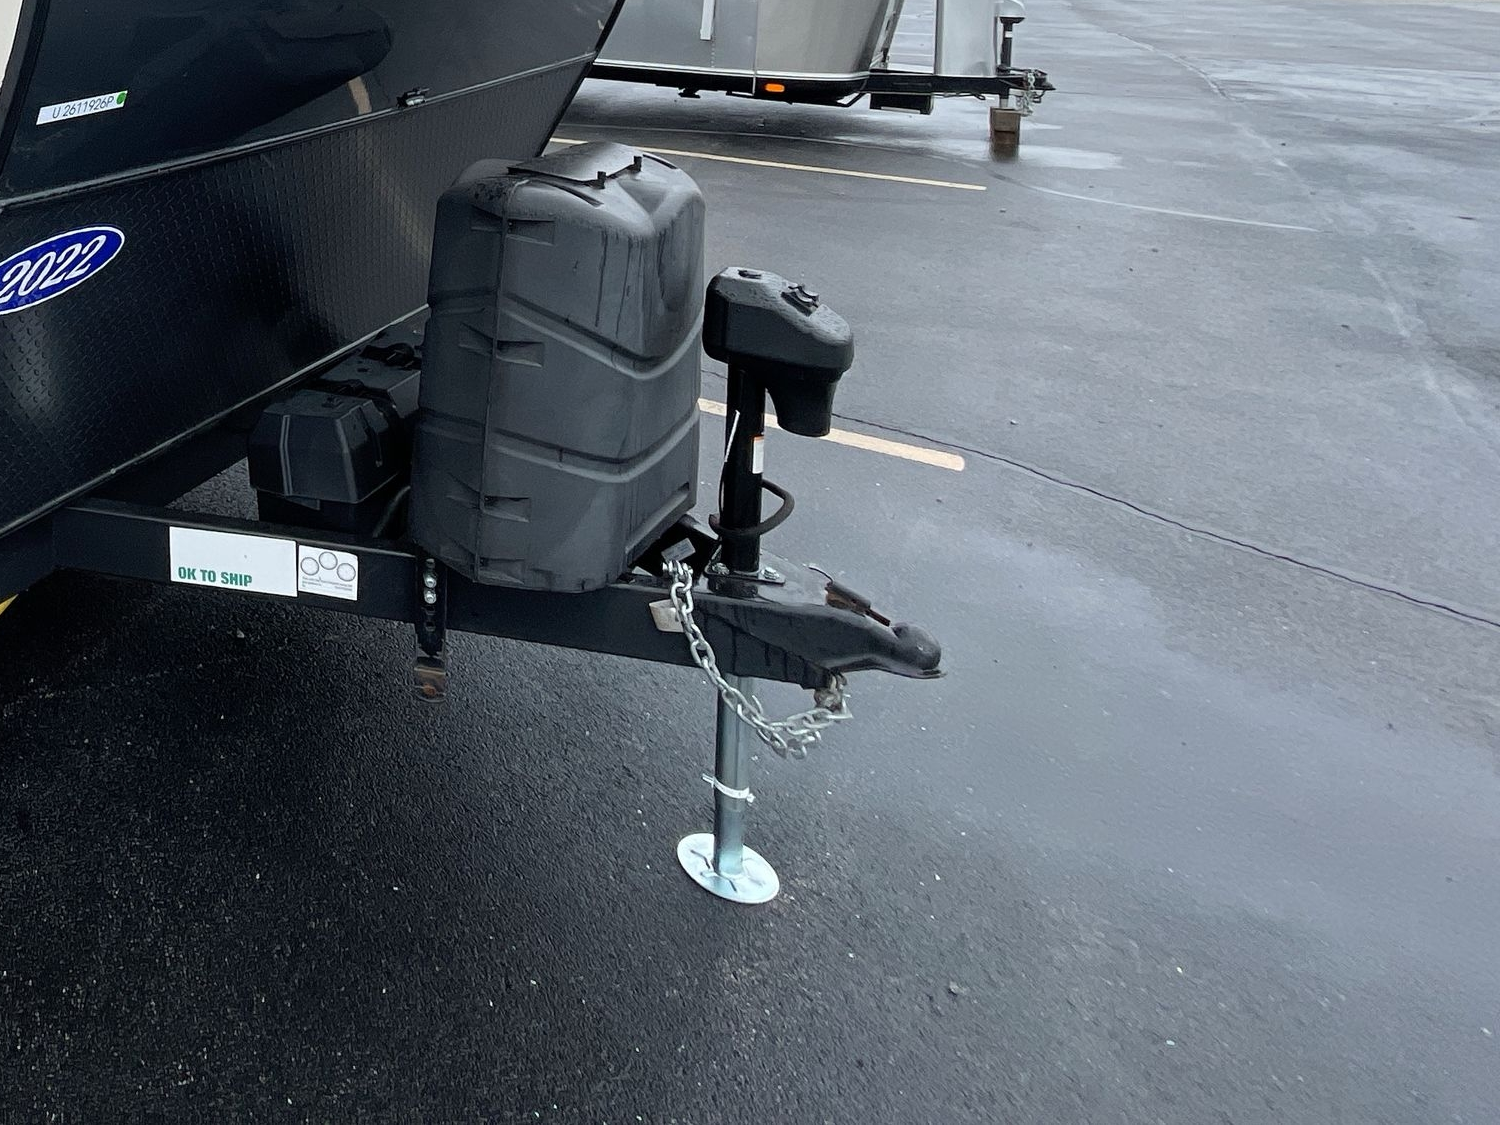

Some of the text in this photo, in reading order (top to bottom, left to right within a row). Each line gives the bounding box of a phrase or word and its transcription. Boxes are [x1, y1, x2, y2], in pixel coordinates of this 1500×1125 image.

[52, 96, 114, 119] U 2611926P
[178, 567, 252, 587] OK TO SHIP
